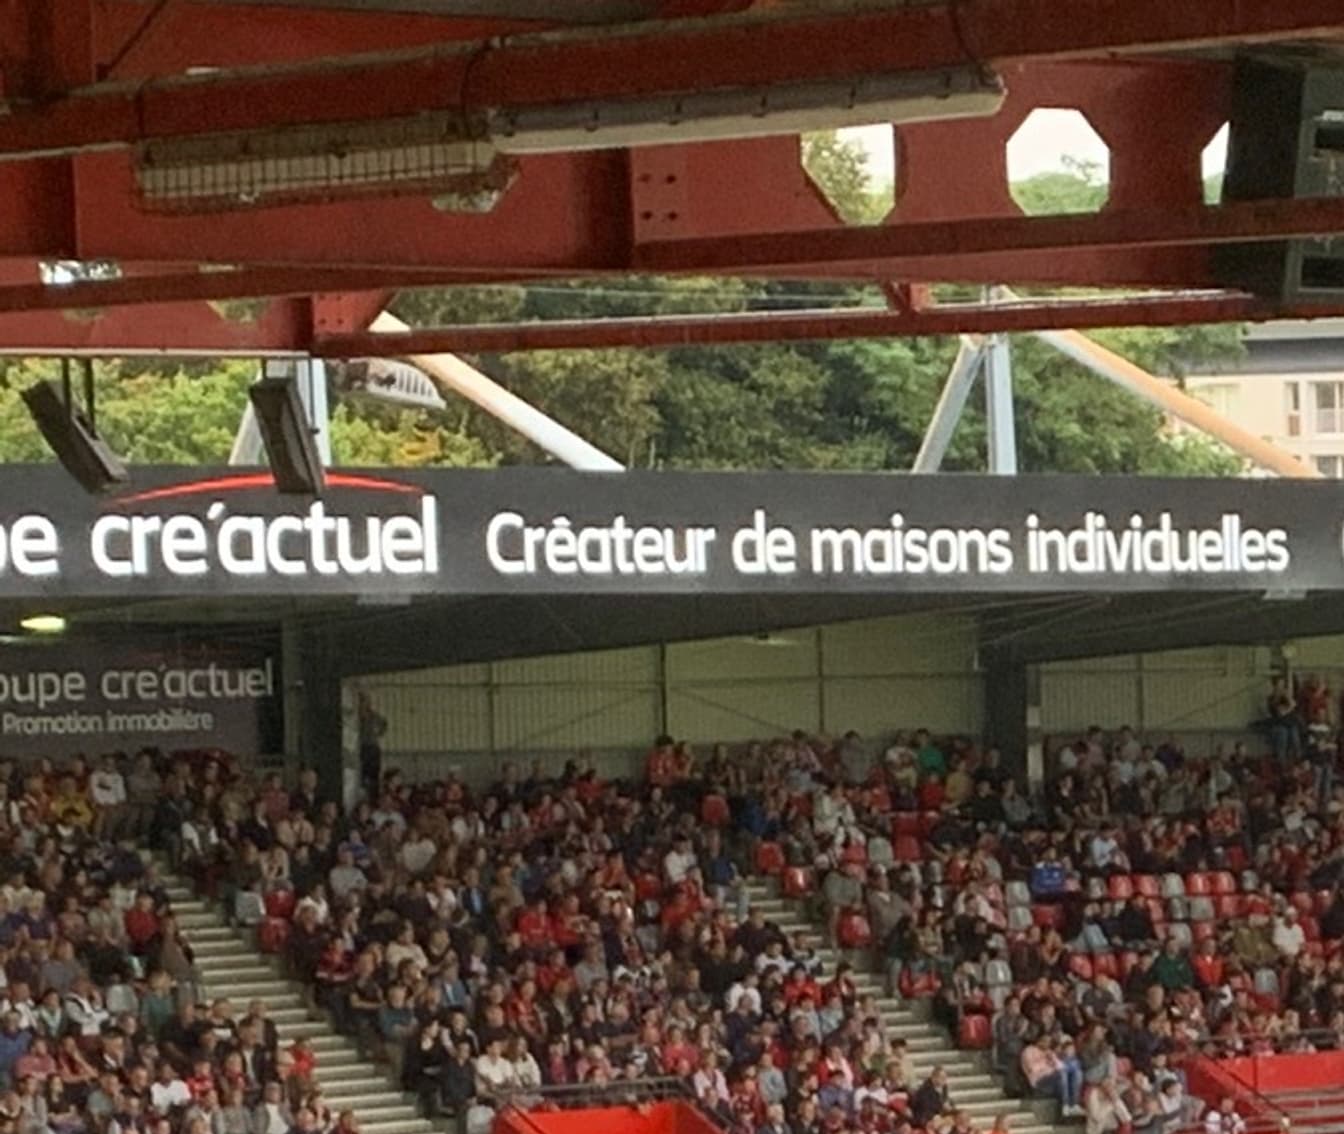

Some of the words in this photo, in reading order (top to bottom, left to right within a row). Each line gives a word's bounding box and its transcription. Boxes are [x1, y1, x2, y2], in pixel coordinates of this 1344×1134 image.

[732, 510, 796, 573] de
[811, 514, 1011, 573] maisons
[1027, 513, 1289, 573] individuelles
[3, 710, 102, 736] Promotion
